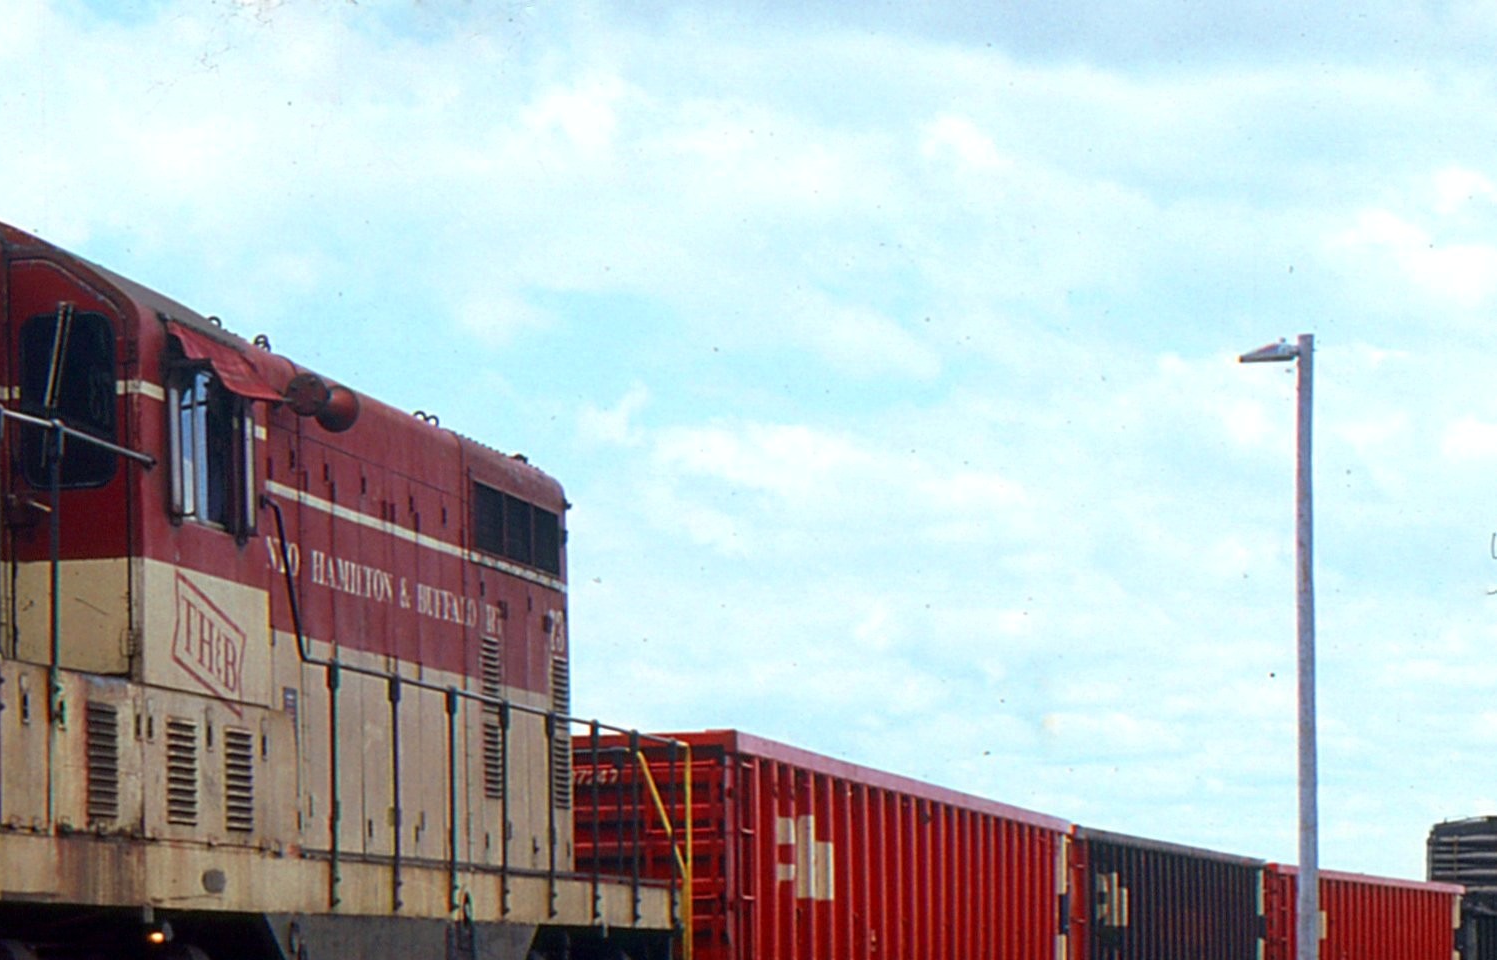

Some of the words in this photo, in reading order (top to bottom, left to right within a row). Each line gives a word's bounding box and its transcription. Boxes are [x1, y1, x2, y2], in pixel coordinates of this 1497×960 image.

[311, 549, 393, 603] HAMILTON
[400, 576, 411, 609] &
[417, 583, 478, 628] BUFFALO
[549, 608, 565, 653] 73
